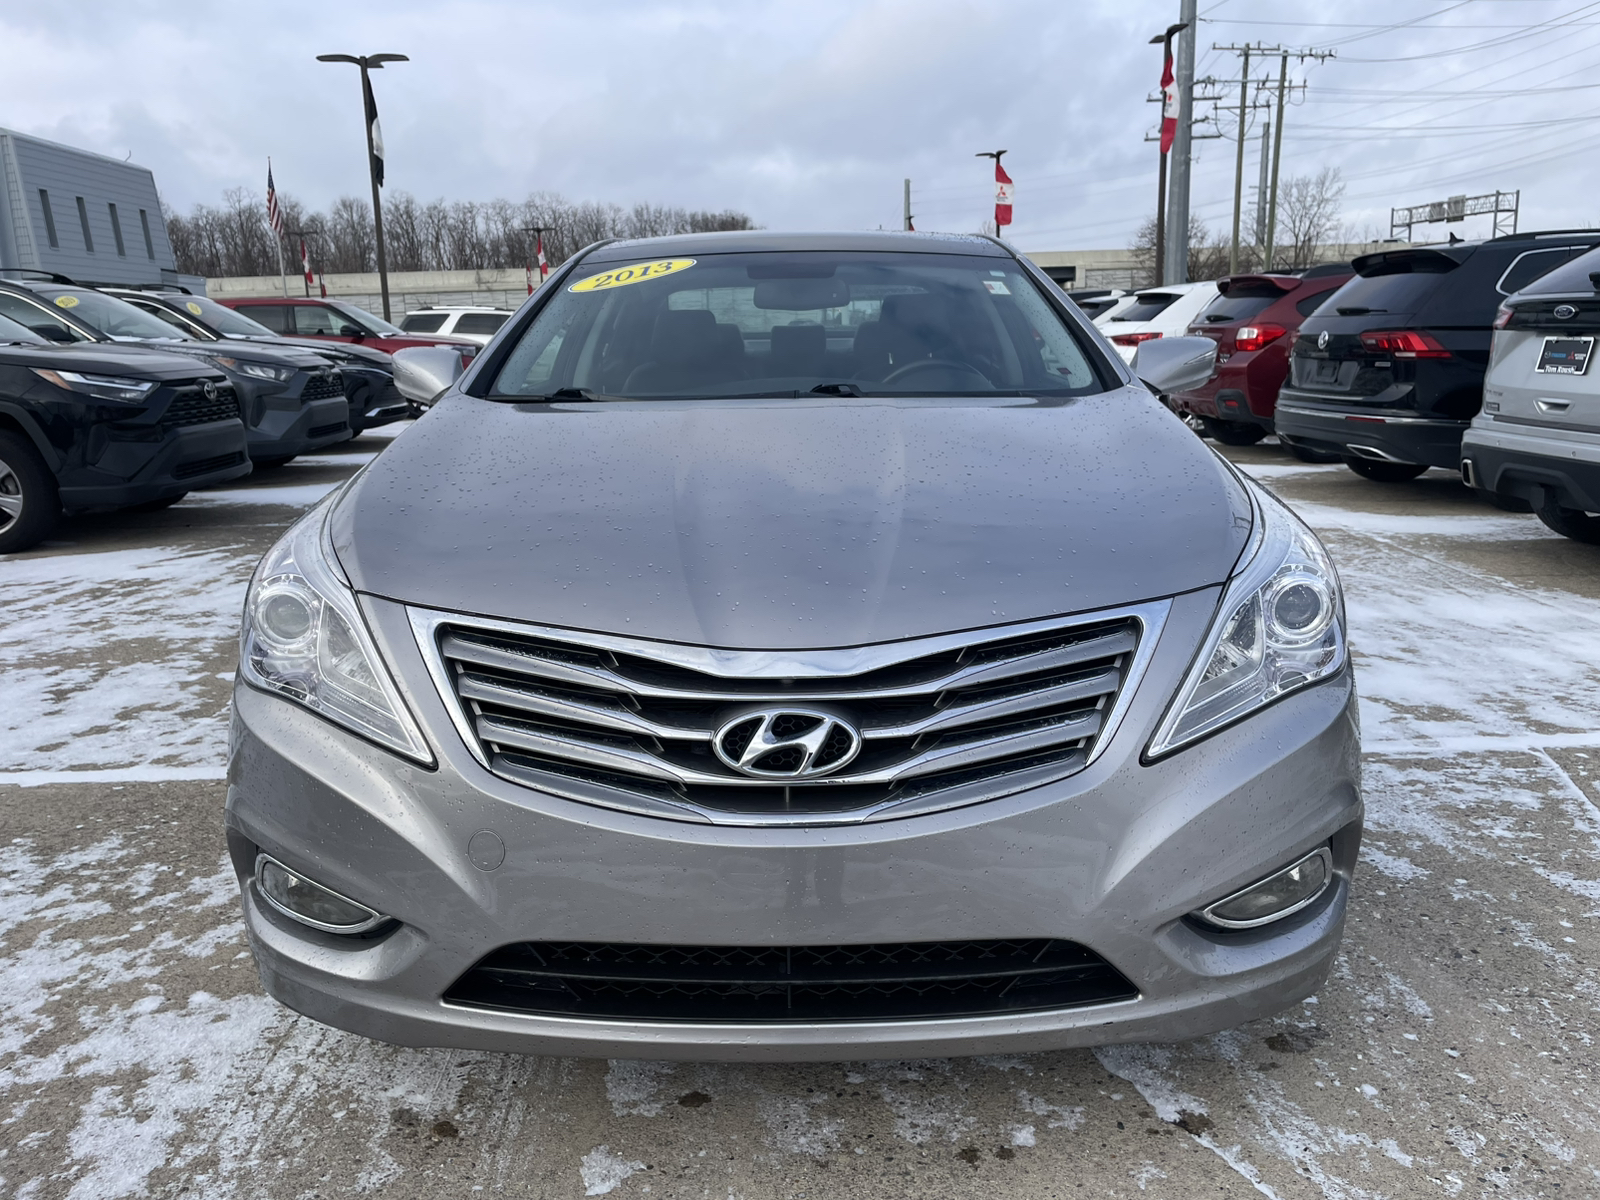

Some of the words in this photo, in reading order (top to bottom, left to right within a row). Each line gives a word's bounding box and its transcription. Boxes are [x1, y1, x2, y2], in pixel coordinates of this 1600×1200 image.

[593, 262, 673, 288] 2013
[1545, 365, 1557, 373] Tom
[1557, 366, 1575, 374] Roush
